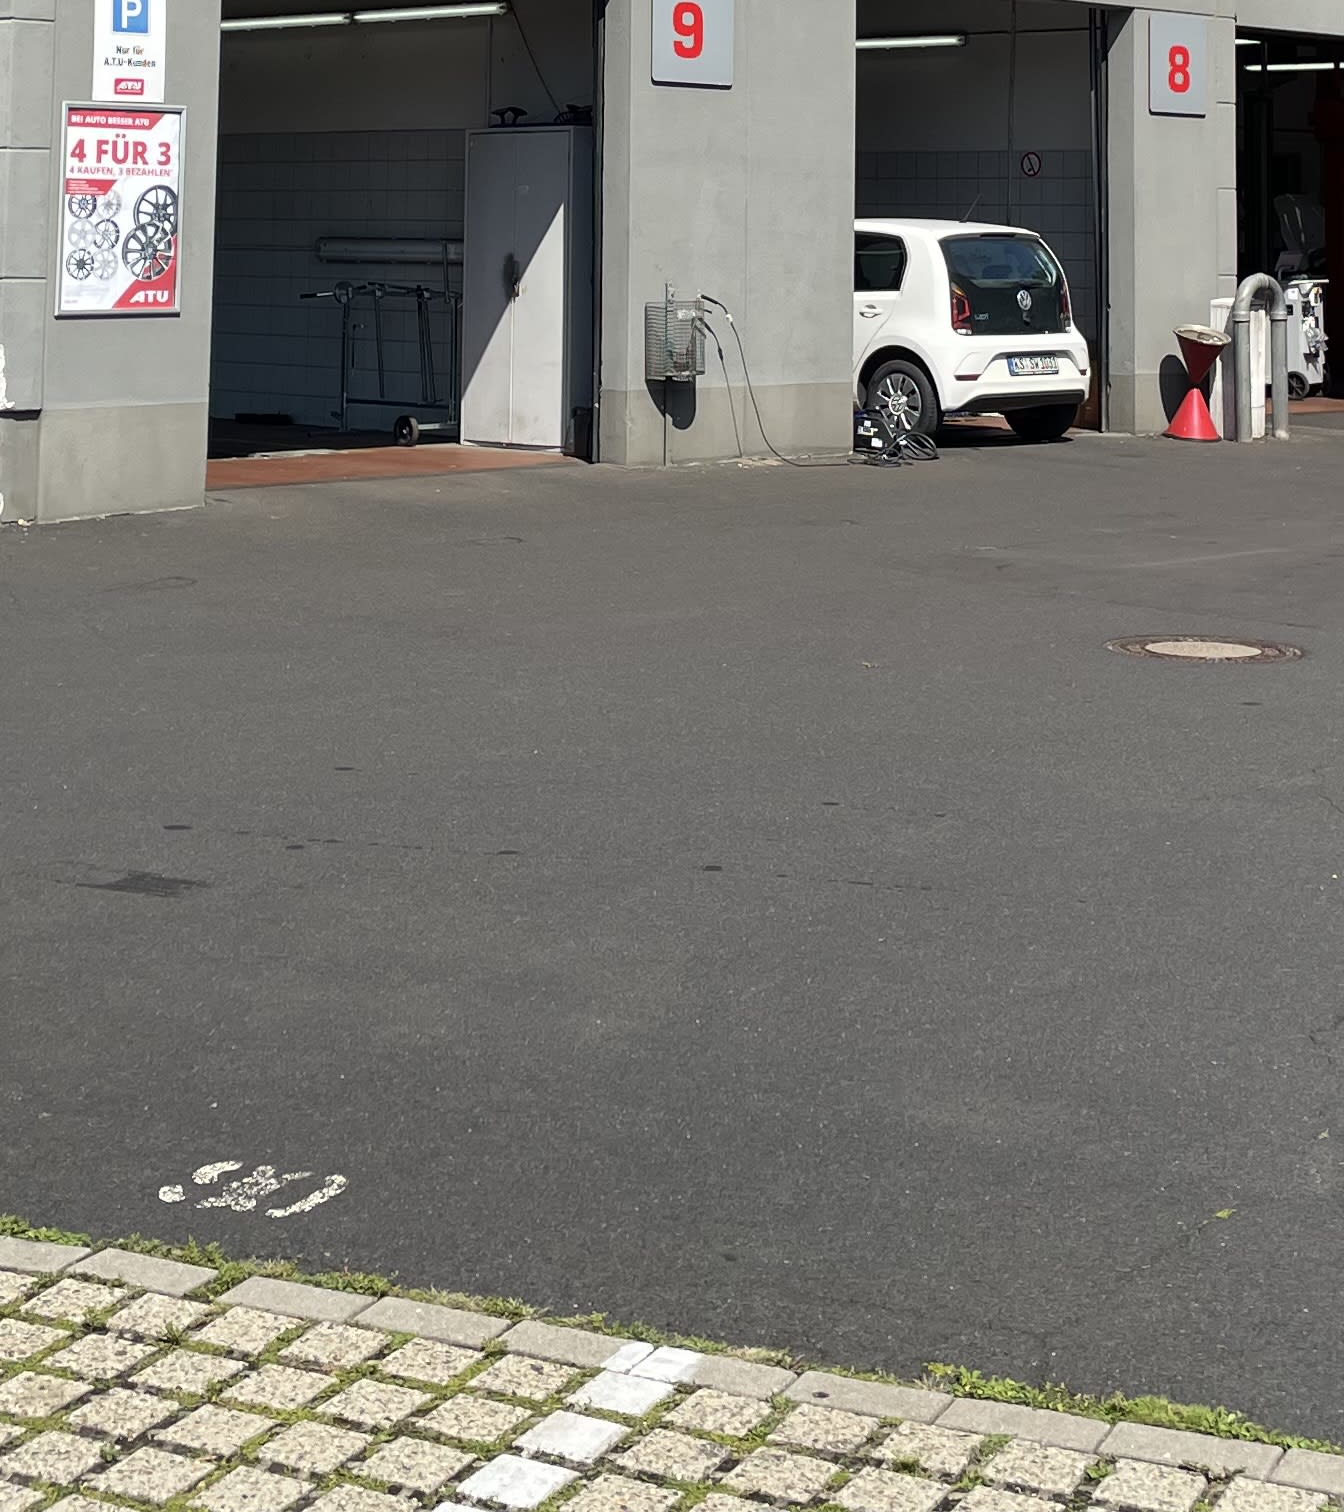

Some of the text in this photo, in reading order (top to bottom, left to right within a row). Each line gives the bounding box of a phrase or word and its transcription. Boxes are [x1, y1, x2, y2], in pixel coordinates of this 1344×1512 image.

[672, 1, 704, 59] 9
[116, 45, 144, 55] Nur für
[1168, 45, 1191, 93] 8
[85, 116, 106, 124] AUTO
[70, 133, 171, 166] 4 FÜR 3
[69, 166, 75, 174] 4
[118, 167, 123, 176] 3
[129, 290, 169, 303] ATU
